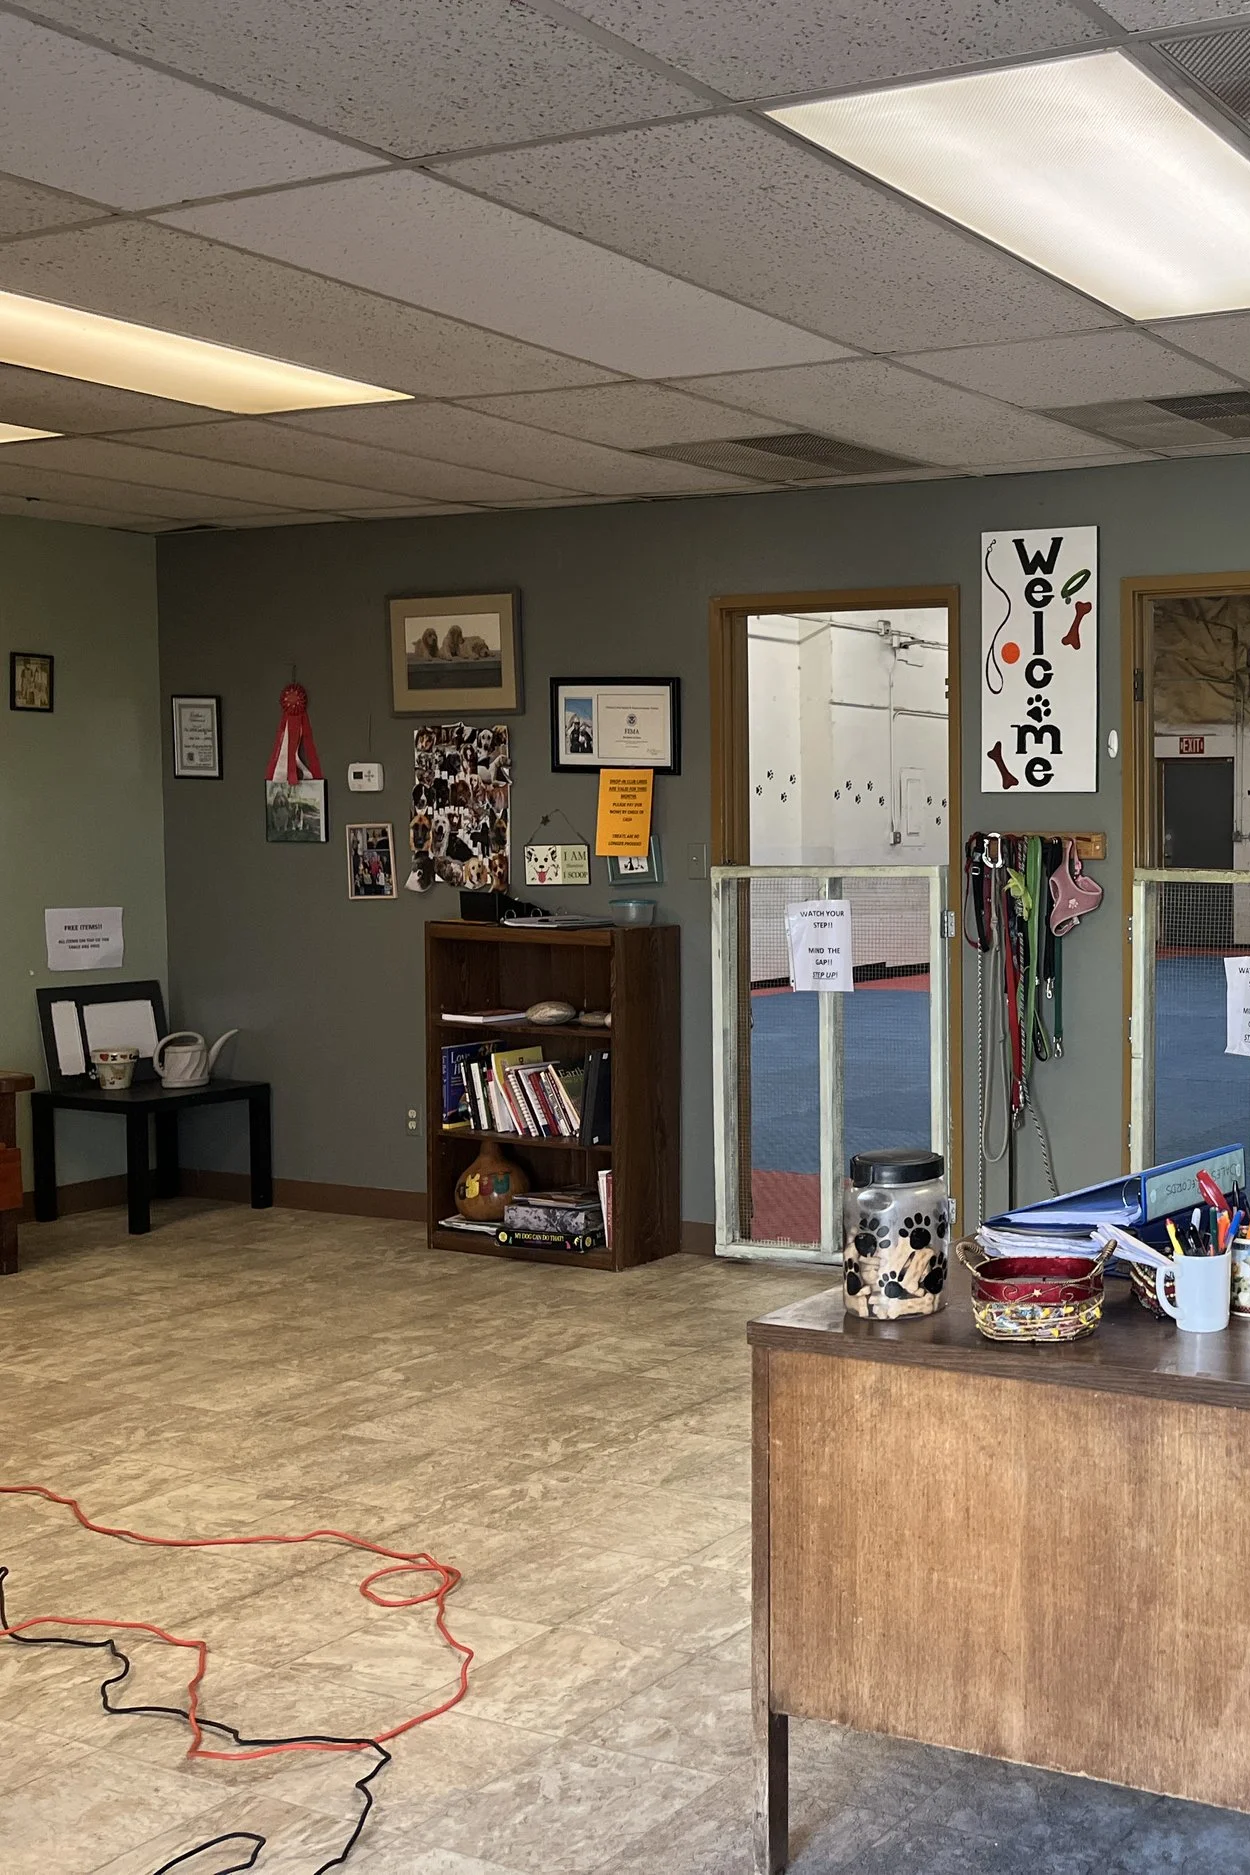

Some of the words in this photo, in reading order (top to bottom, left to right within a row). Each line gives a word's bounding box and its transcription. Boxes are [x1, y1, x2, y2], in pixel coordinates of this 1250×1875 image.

[1183, 738, 1200, 753] EXIT
[571, 851, 586, 861] AM
[567, 871, 588, 879] SCOOP
